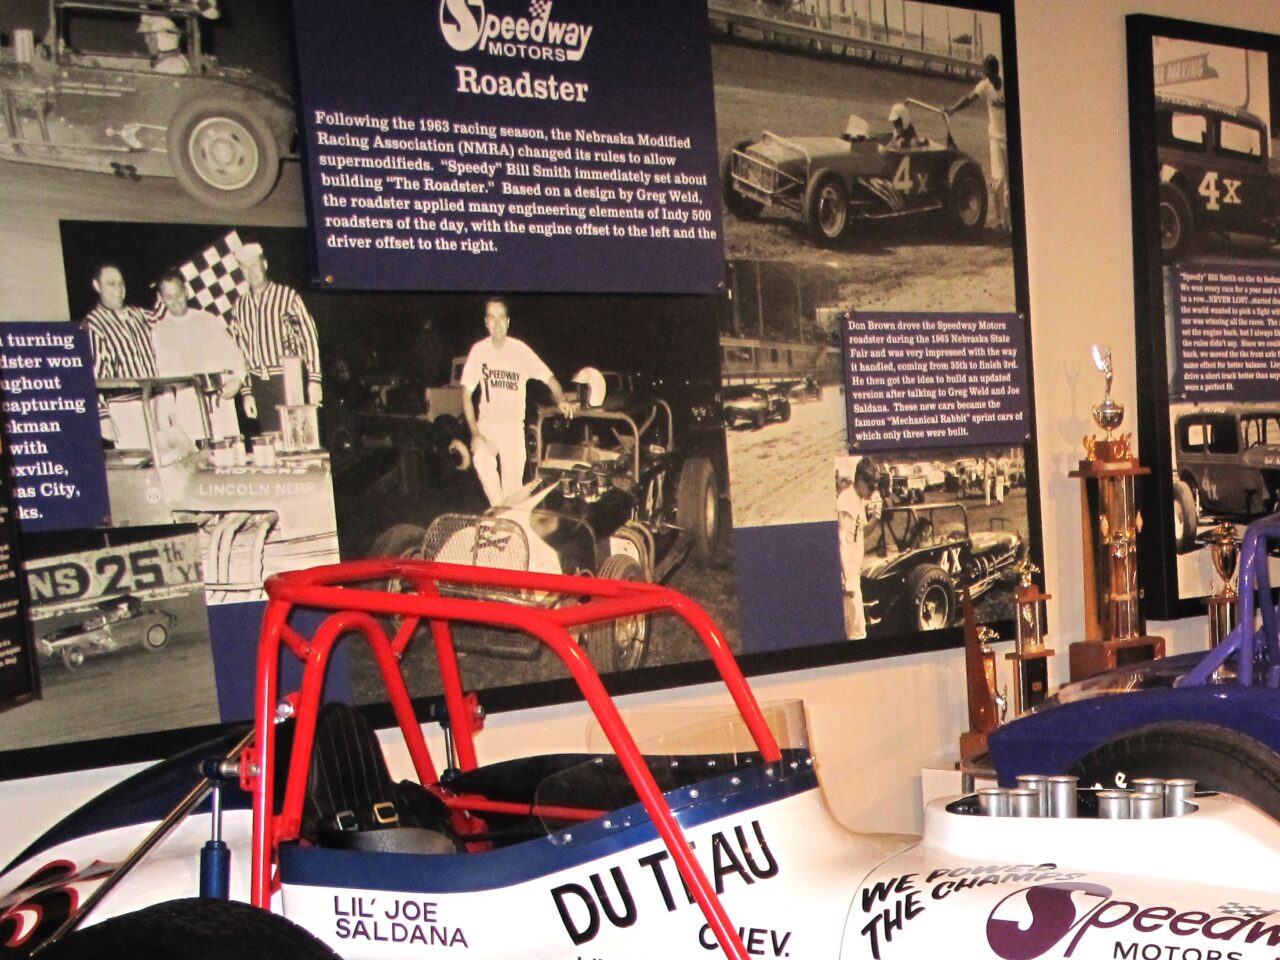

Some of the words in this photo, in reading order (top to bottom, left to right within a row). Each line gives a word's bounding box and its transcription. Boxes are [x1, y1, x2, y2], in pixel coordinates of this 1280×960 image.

[439, 0, 593, 62] Speedway
[488, 41, 567, 62] MOTORS
[454, 65, 589, 102] Roadster
[314, 110, 389, 132] Following
[392, 116, 415, 130] the
[419, 118, 449, 132] 1963
[453, 121, 497, 139] racing
[499, 126, 548, 141] season,
[550, 128, 571, 141] the
[574, 129, 634, 145] Nebraska
[637, 133, 690, 149] Modified
[317, 131, 369, 150] Racing
[373, 135, 454, 152] Association
[458, 140, 514, 158] (NMRA)
[517, 144, 572, 161] changed
[575, 148, 591, 161] its
[594, 150, 625, 163] rules
[628, 151, 640, 163] to
[643, 152, 676, 165] allow
[319, 155, 433, 171] supermodifieds.
[505, 162, 529, 176] Bill
[532, 164, 571, 178] Smith
[574, 166, 651, 185] immediately
[653, 172, 671, 184] set
[674, 172, 707, 185] about
[320, 172, 383, 191] building
[501, 181, 541, 195] Based
[544, 186, 560, 196] on
[563, 187, 571, 197] a
[574, 185, 616, 201] design
[618, 187, 633, 203] by
[636, 188, 666, 204] Greg
[668, 190, 702, 205] Weld,
[323, 193, 346, 207] the
[350, 195, 410, 209] roadster
[414, 198, 464, 214] applied
[468, 202, 505, 216] many
[508, 202, 586, 219] engineering
[588, 204, 644, 219] elements
[647, 207, 659, 219] of
[661, 207, 689, 223] Indy
[692, 209, 711, 221] 500
[325, 214, 393, 229] roadsters
[396, 216, 410, 229] of
[413, 217, 436, 230] the
[439, 217, 467, 234] day,
[470, 219, 501, 232] with
[503, 220, 525, 233] the
[528, 221, 572, 237] engine
[575, 222, 610, 236] offset
[612, 224, 625, 236] to
[627, 224, 647, 237] the
[650, 225, 670, 237] left
[673, 226, 695, 238] and
[697, 227, 716, 239] the
[327, 234, 372, 248] driver
[375, 235, 415, 249] offset
[417, 237, 431, 250] to
[434, 237, 457, 250] the
[460, 238, 497, 254] right.
[848, 320, 865, 330] Don
[867, 320, 895, 330] Brown
[897, 320, 920, 330] drove
[922, 320, 935, 330] the
[937, 320, 976, 332] Speedway
[978, 320, 1006, 330] Motors
[8, 332, 75, 349] turning
[849, 334, 884, 344] roadster
[886, 334, 914, 345] during
[915, 334, 929, 343] the
[931, 334, 949, 343] 1965
[950, 334, 988, 343] Nebraska
[990, 333, 1010, 343] State
[0, 355, 42, 368] dster
[46, 357, 83, 368] won
[850, 348, 868, 357] Fair
[870, 348, 886, 357] and
[905, 349, 923, 359] very
[925, 346, 966, 359] impressed
[967, 347, 985, 356] with
[987, 347, 1000, 356] the
[1001, 348, 1017, 357] way
[491, 380, 519, 391] MOTORS
[9, 440, 49, 455] with
[41, 482, 81, 499] City,
[199, 482, 270, 496] LINCOLN
[95, 549, 165, 596] 25
[861, 873, 920, 913] WE
[925, 863, 1057, 883] POWER
[384, 899, 438, 923] JOE
[551, 867, 637, 946] DU
[860, 890, 926, 960] THE
[931, 872, 1087, 900] CHAMPS
[336, 917, 469, 949] SALDANA
